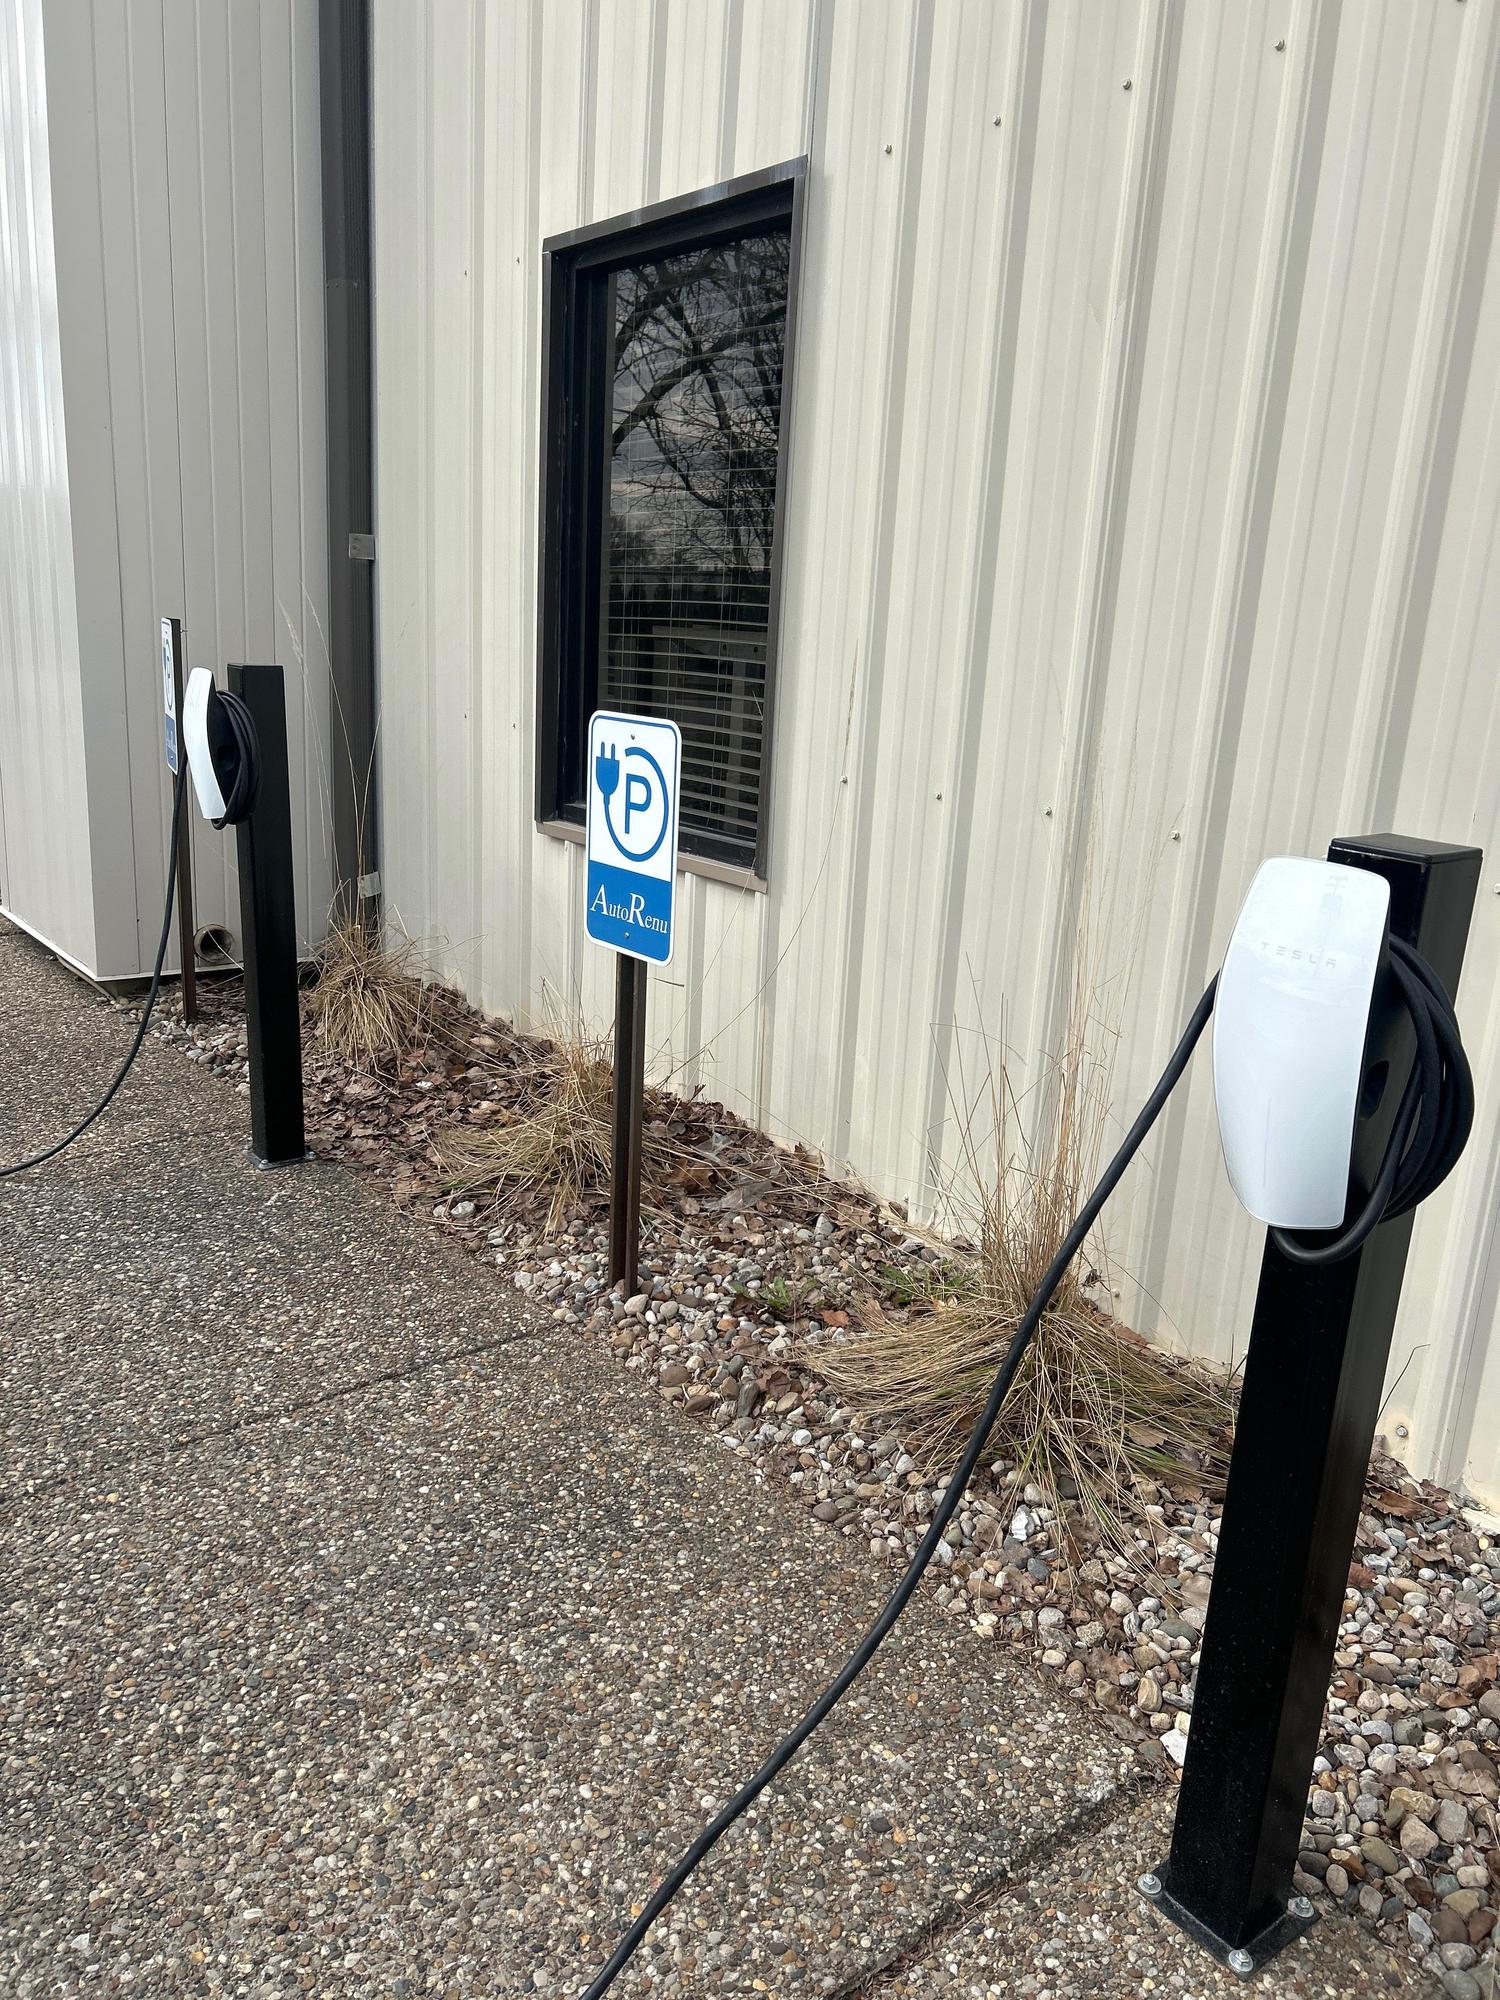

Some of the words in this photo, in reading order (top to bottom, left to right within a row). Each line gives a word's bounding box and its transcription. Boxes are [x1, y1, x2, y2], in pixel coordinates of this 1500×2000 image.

[624, 773, 652, 834] P
[590, 883, 668, 934] AutoRenu
[1261, 941, 1337, 969] TESLA
